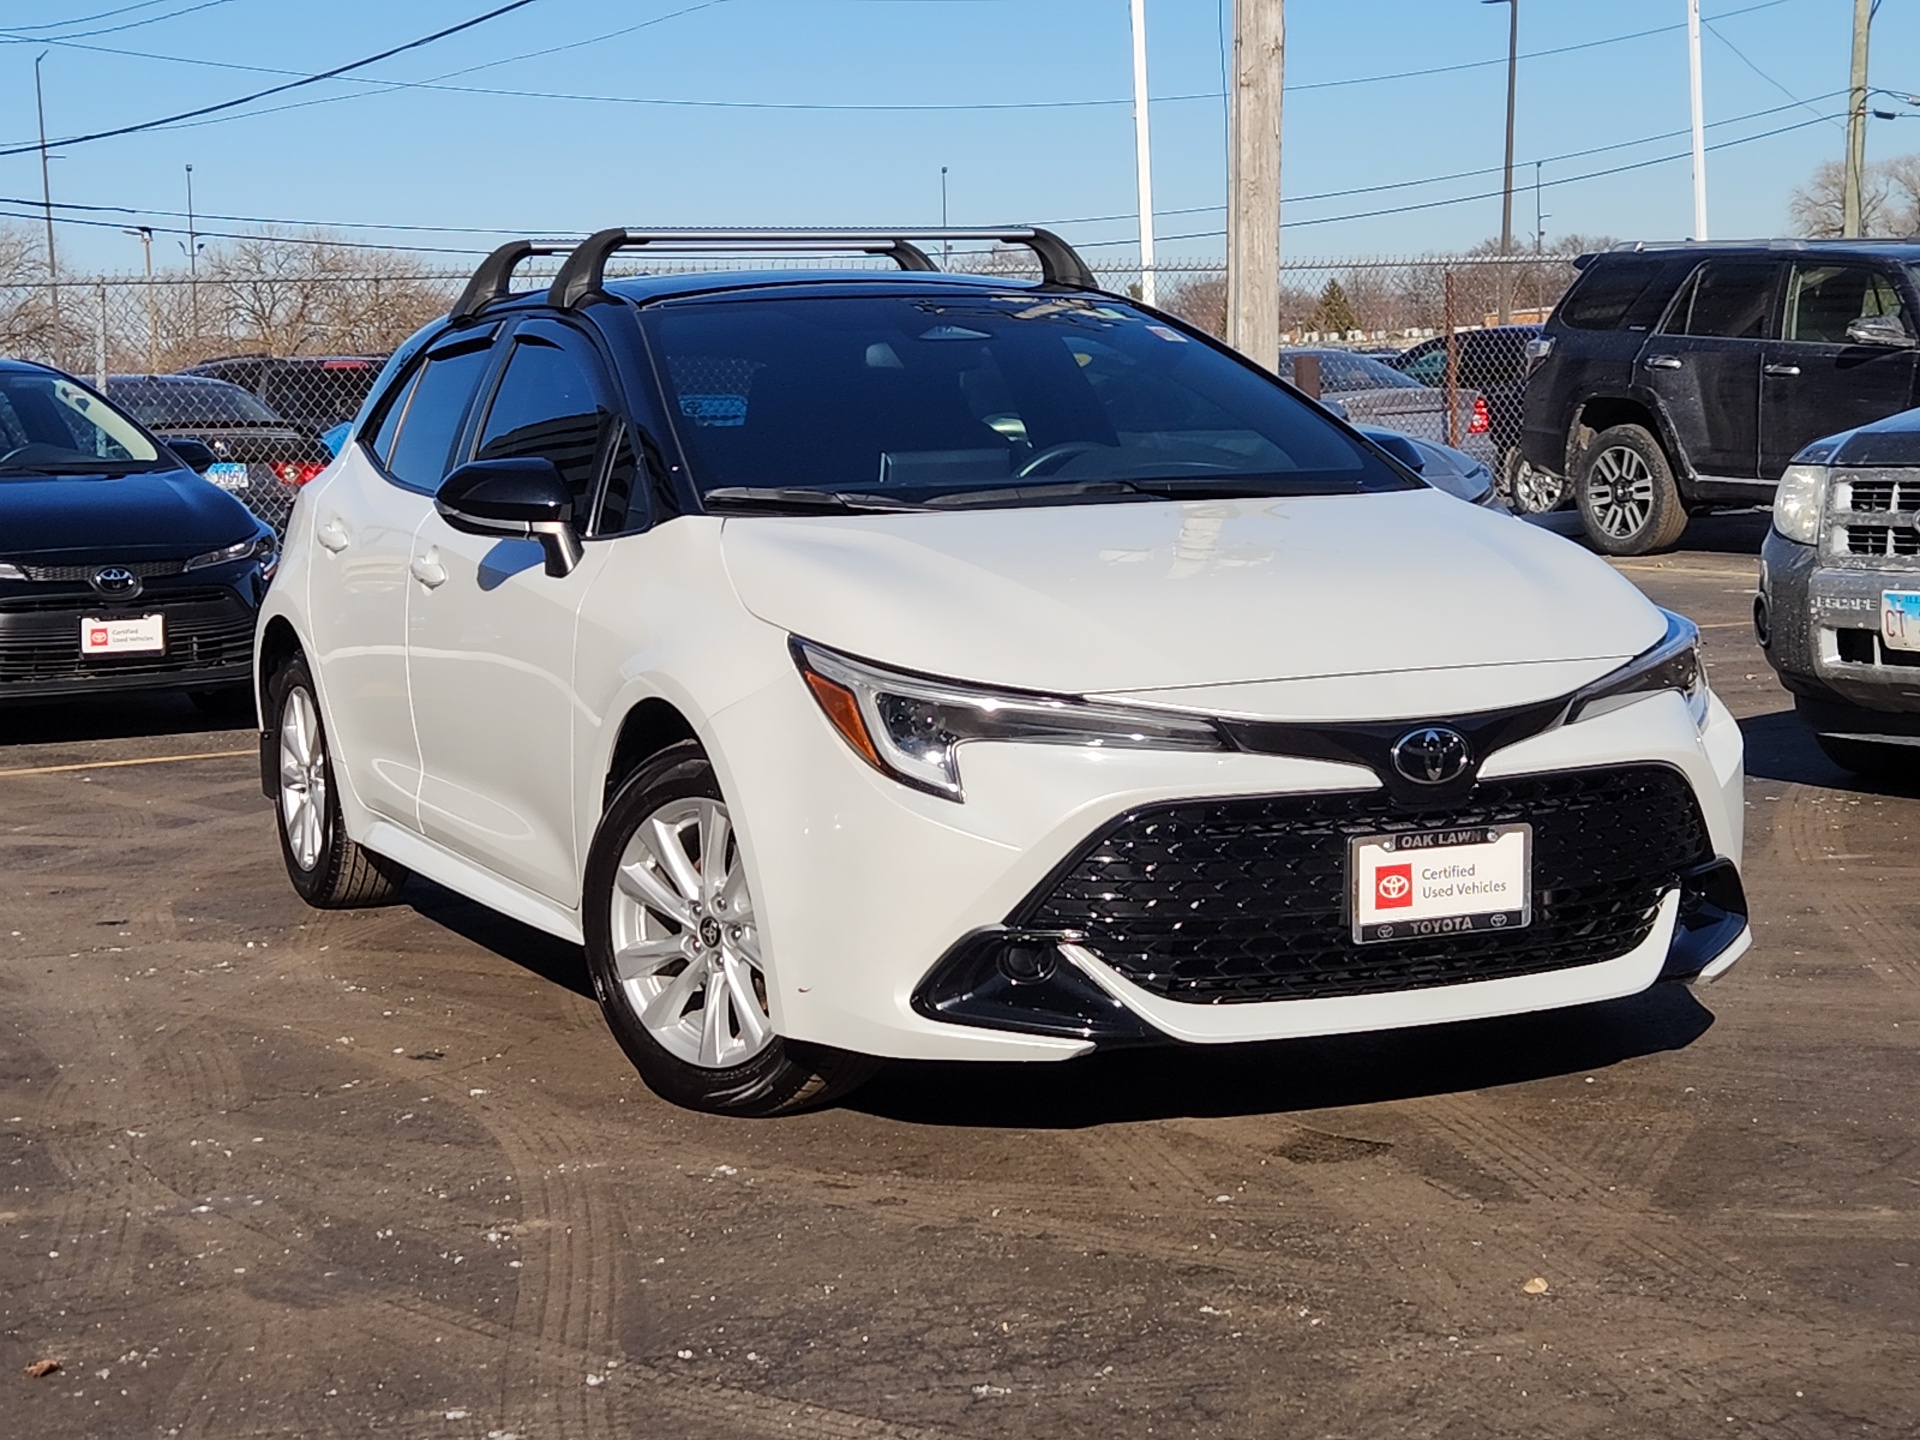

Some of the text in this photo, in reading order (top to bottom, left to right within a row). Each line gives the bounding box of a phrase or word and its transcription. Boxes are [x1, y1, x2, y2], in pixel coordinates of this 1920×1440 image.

[1401, 830, 1481, 848] OAK LAWN
[1421, 864, 1476, 880] Certified
[1422, 880, 1507, 899] Used Vehicles
[1410, 917, 1473, 934] TOYOTA
